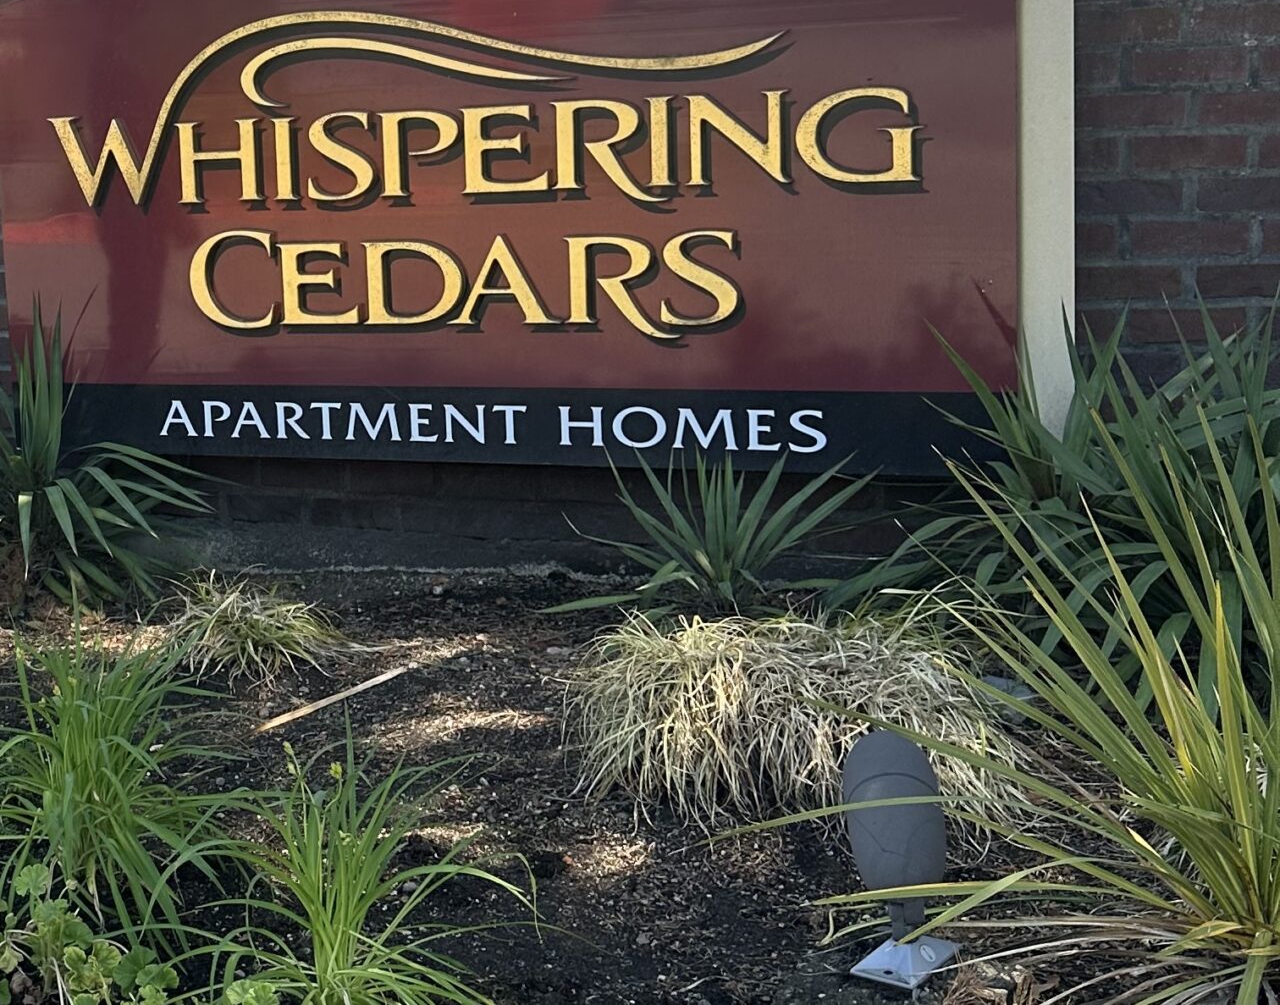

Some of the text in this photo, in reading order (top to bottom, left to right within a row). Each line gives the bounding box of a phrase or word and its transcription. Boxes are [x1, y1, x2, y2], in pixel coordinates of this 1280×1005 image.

[47, 86, 923, 207] WHISPERING
[189, 229, 739, 341] CEDARS
[160, 399, 828, 453] APARTMENT HOMES
